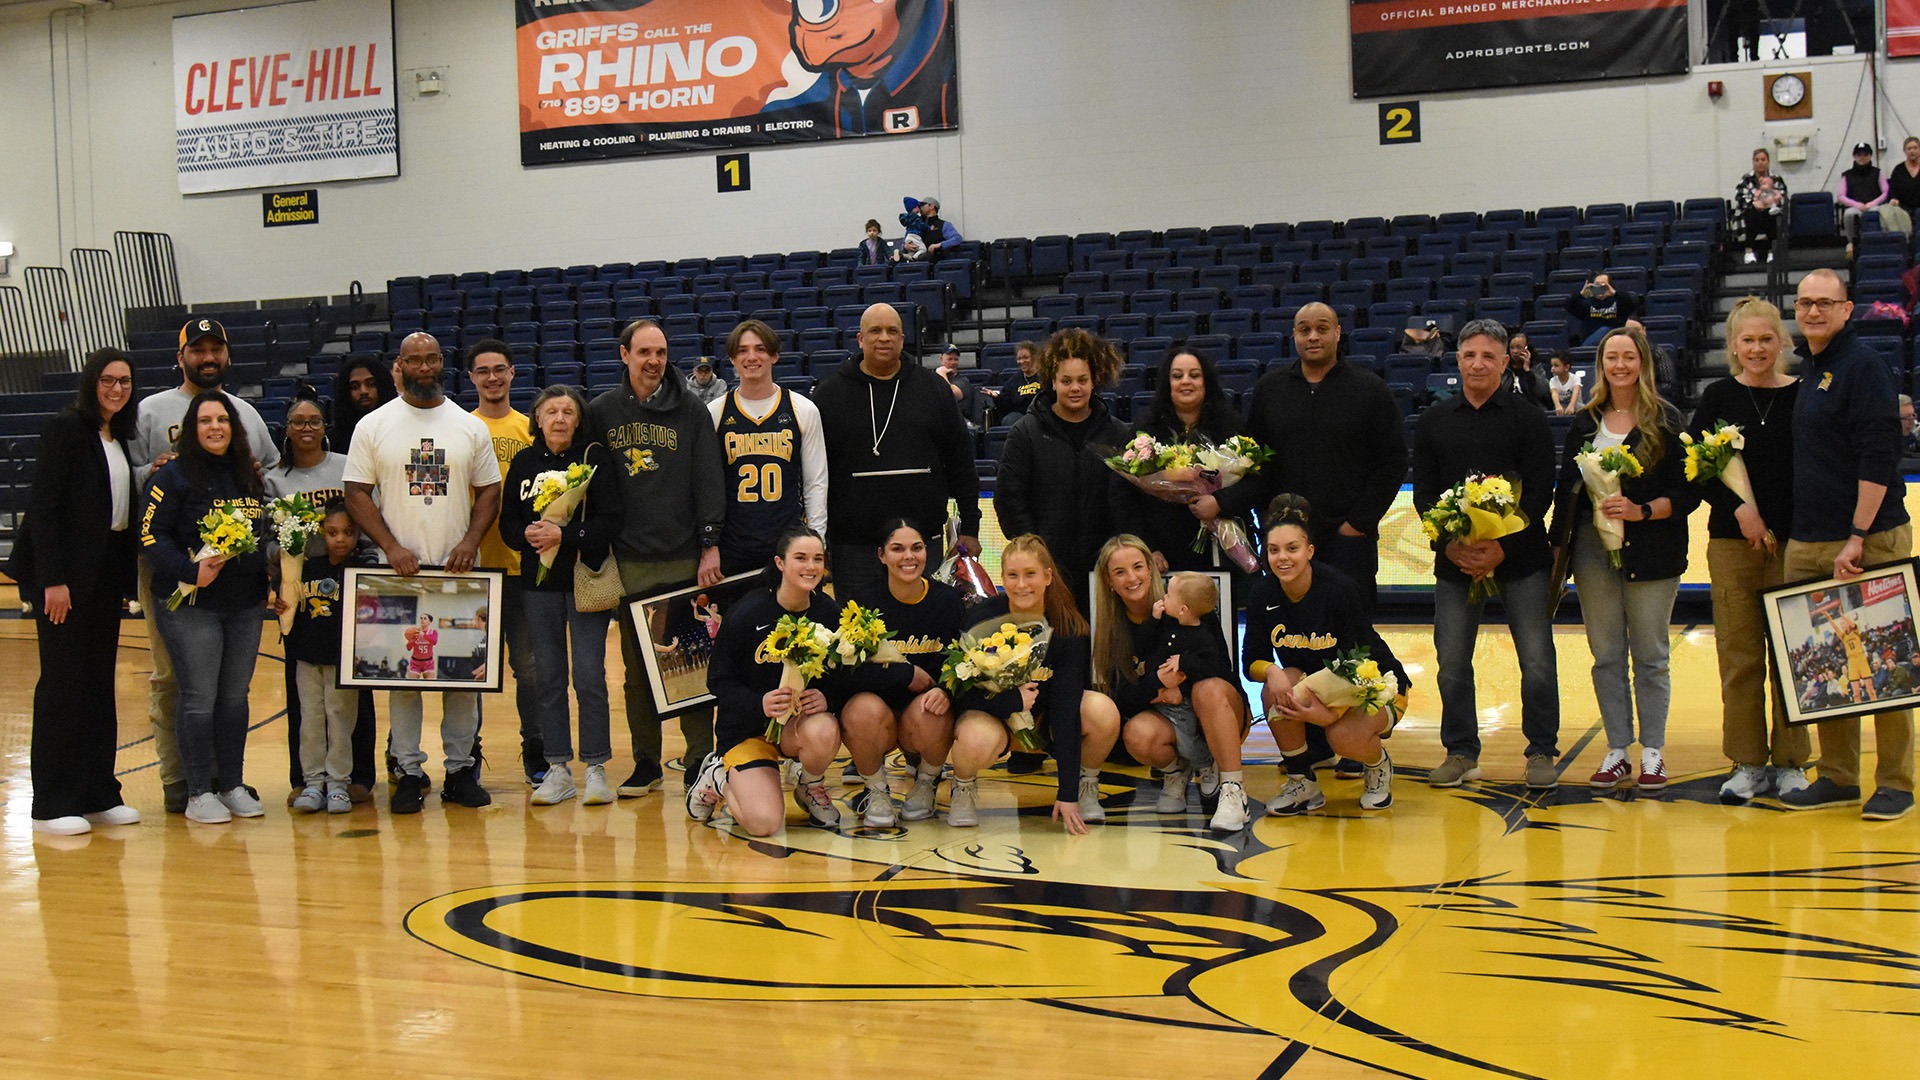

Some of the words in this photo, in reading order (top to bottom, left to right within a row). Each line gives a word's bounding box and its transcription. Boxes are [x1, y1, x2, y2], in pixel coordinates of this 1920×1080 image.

[1380, 8, 1435, 21] OFFICIAL
[1439, 2, 1497, 16] BRANDED
[536, 22, 639, 50] GRIFFS
[644, 27, 679, 39] CALL
[684, 23, 713, 35] THE
[1445, 41, 1590, 60] ADPROSPORTS.COM
[185, 43, 381, 115] CLEVE-HILL
[538, 35, 758, 95] RHINO
[563, 84, 715, 117] 899-HORN
[539, 139, 581, 151] HEATING
[582, 138, 591, 147] &
[593, 135, 636, 146] COOLING
[648, 129, 700, 142] PLUMBING
[701, 128, 710, 137] &
[712, 125, 752, 136] DRAINS
[765, 119, 814, 132] ELECTRIC
[892, 112, 910, 130] R
[1386, 107, 1413, 139] 2
[193, 130, 271, 163] AUTO
[283, 127, 301, 154] &
[312, 118, 379, 150] TIRE
[724, 159, 740, 187] 1
[272, 191, 308, 208] General
[266, 207, 315, 223] Admission
[606, 422, 678, 451] CANISIUS
[725, 429, 793, 465] CANISIUS
[737, 463, 782, 502] 20
